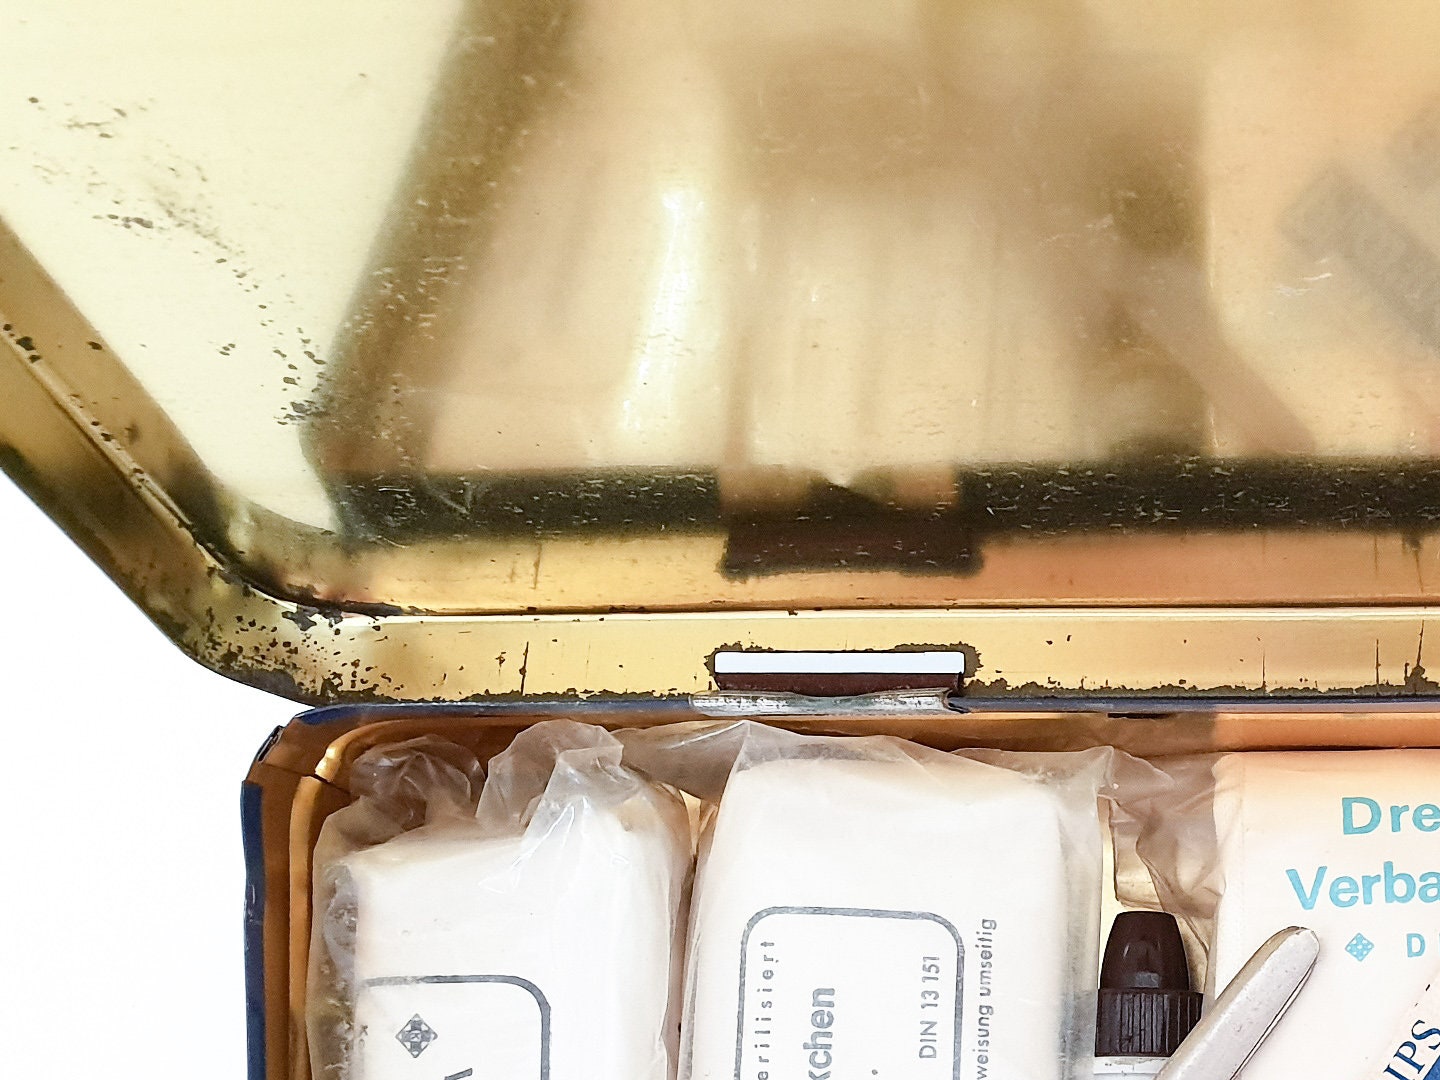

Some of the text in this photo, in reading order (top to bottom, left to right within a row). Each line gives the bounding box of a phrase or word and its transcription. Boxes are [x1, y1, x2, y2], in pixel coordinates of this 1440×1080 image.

[922, 955, 940, 983] 151
[974, 918, 997, 997] umseitig
[921, 990, 939, 1009] 13
[919, 1020, 937, 1059] DIN
